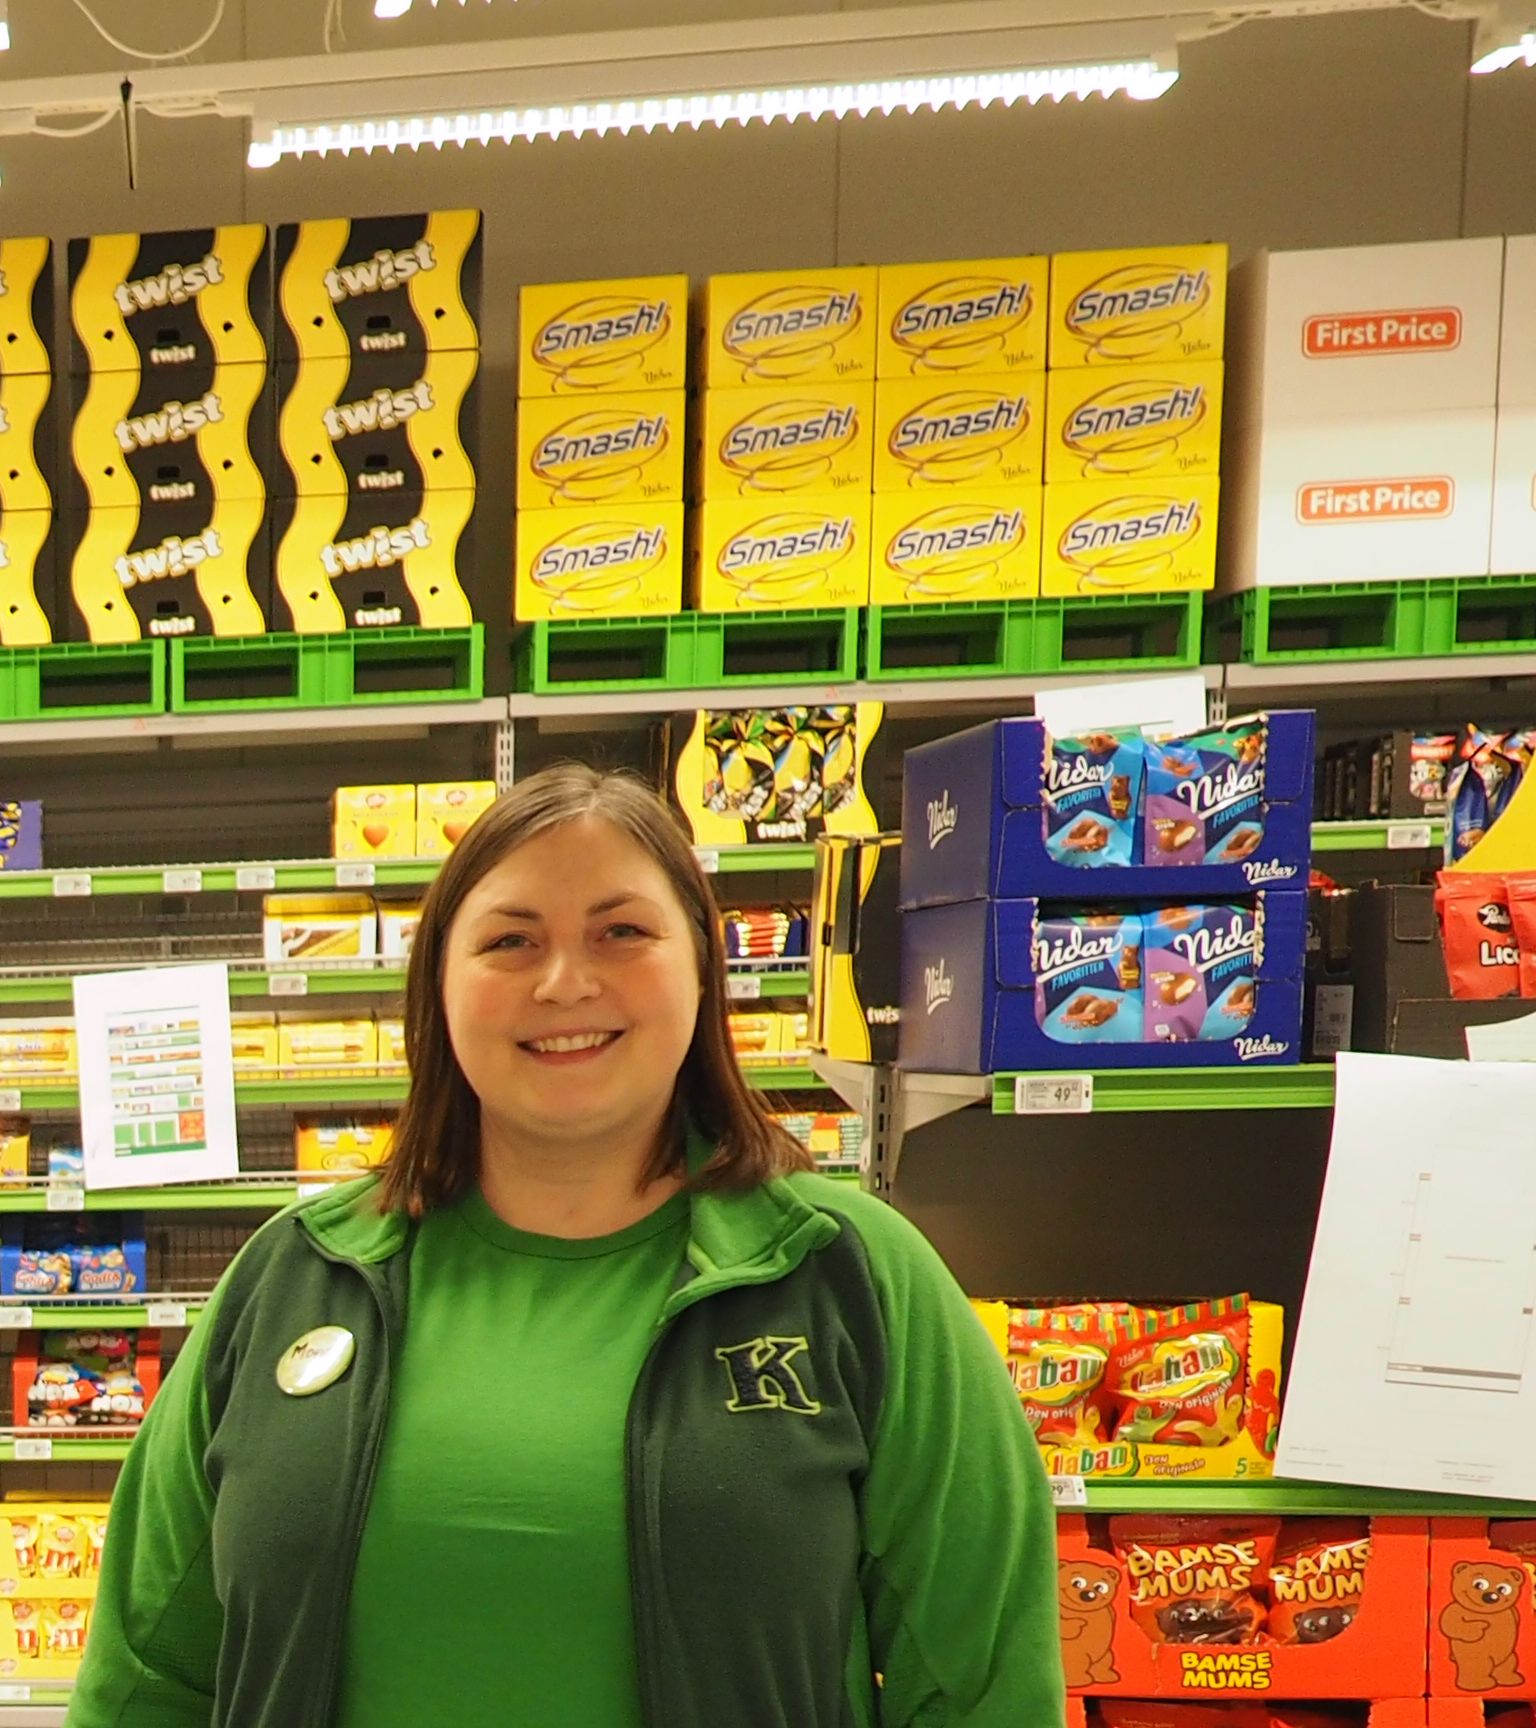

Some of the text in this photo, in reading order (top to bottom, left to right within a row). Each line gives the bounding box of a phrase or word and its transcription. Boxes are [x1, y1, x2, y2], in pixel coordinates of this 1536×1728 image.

[729, 292, 857, 344] Smash!
[889, 280, 1027, 335] Smash!
[1070, 270, 1207, 325] Smash!
[539, 301, 666, 354] Smash!
[1316, 317, 1448, 347] First Price
[724, 403, 858, 460] Smash!
[888, 394, 1025, 450] Smash!
[1066, 384, 1202, 441] Smash!
[538, 414, 664, 470] Smash!
[1309, 484, 1441, 514] First Price
[536, 525, 663, 581] Smash!
[723, 516, 851, 570] Smash!
[886, 505, 1023, 563] Smash!
[1065, 499, 1199, 554] Smash!
[1242, 859, 1297, 885] Nidar
[1233, 1035, 1289, 1060] Nidar
[715, 1335, 821, 1415] K
[1127, 1540, 1260, 1580] BAMSE
[1137, 1566, 1252, 1600] MUMS
[1181, 1651, 1273, 1671] BAMSE
[1182, 1670, 1270, 1689] MUMS
